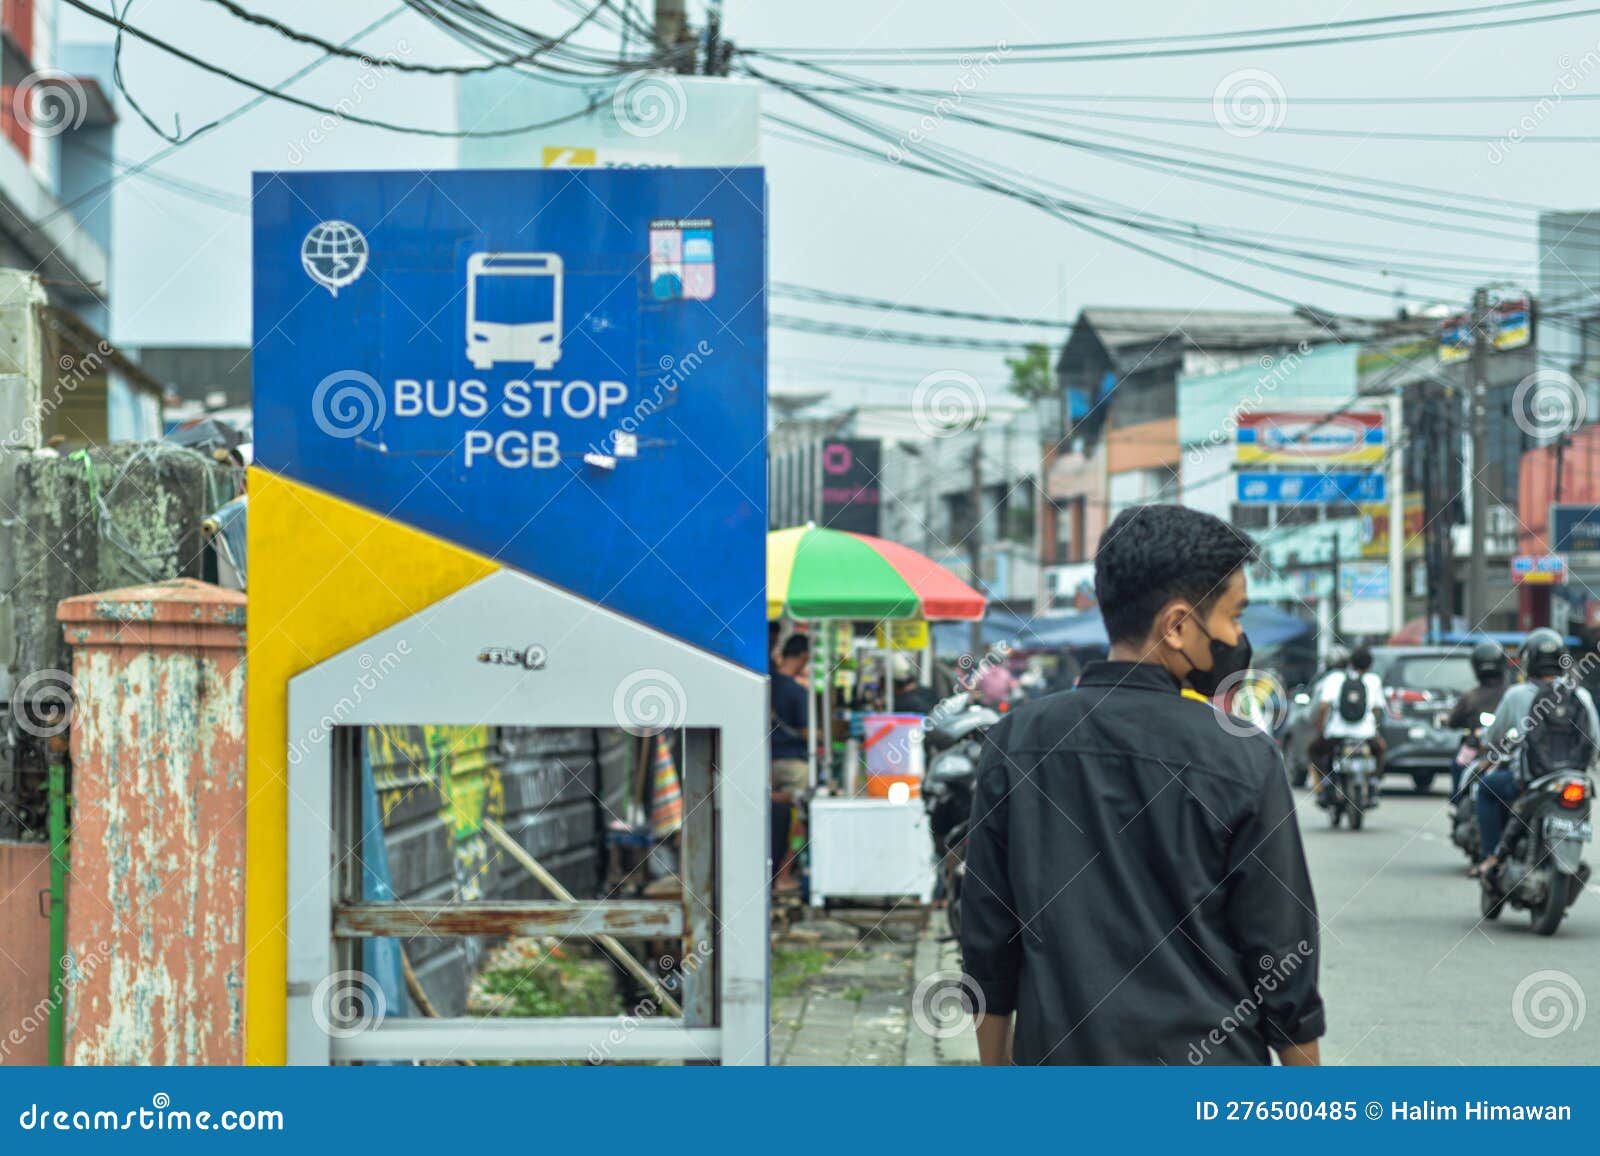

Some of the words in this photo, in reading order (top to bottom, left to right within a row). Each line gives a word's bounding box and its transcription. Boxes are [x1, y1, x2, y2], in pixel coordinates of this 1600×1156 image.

[394, 378, 489, 418] BUS
[502, 379, 628, 419] STOP
[464, 430, 560, 469] PGB
